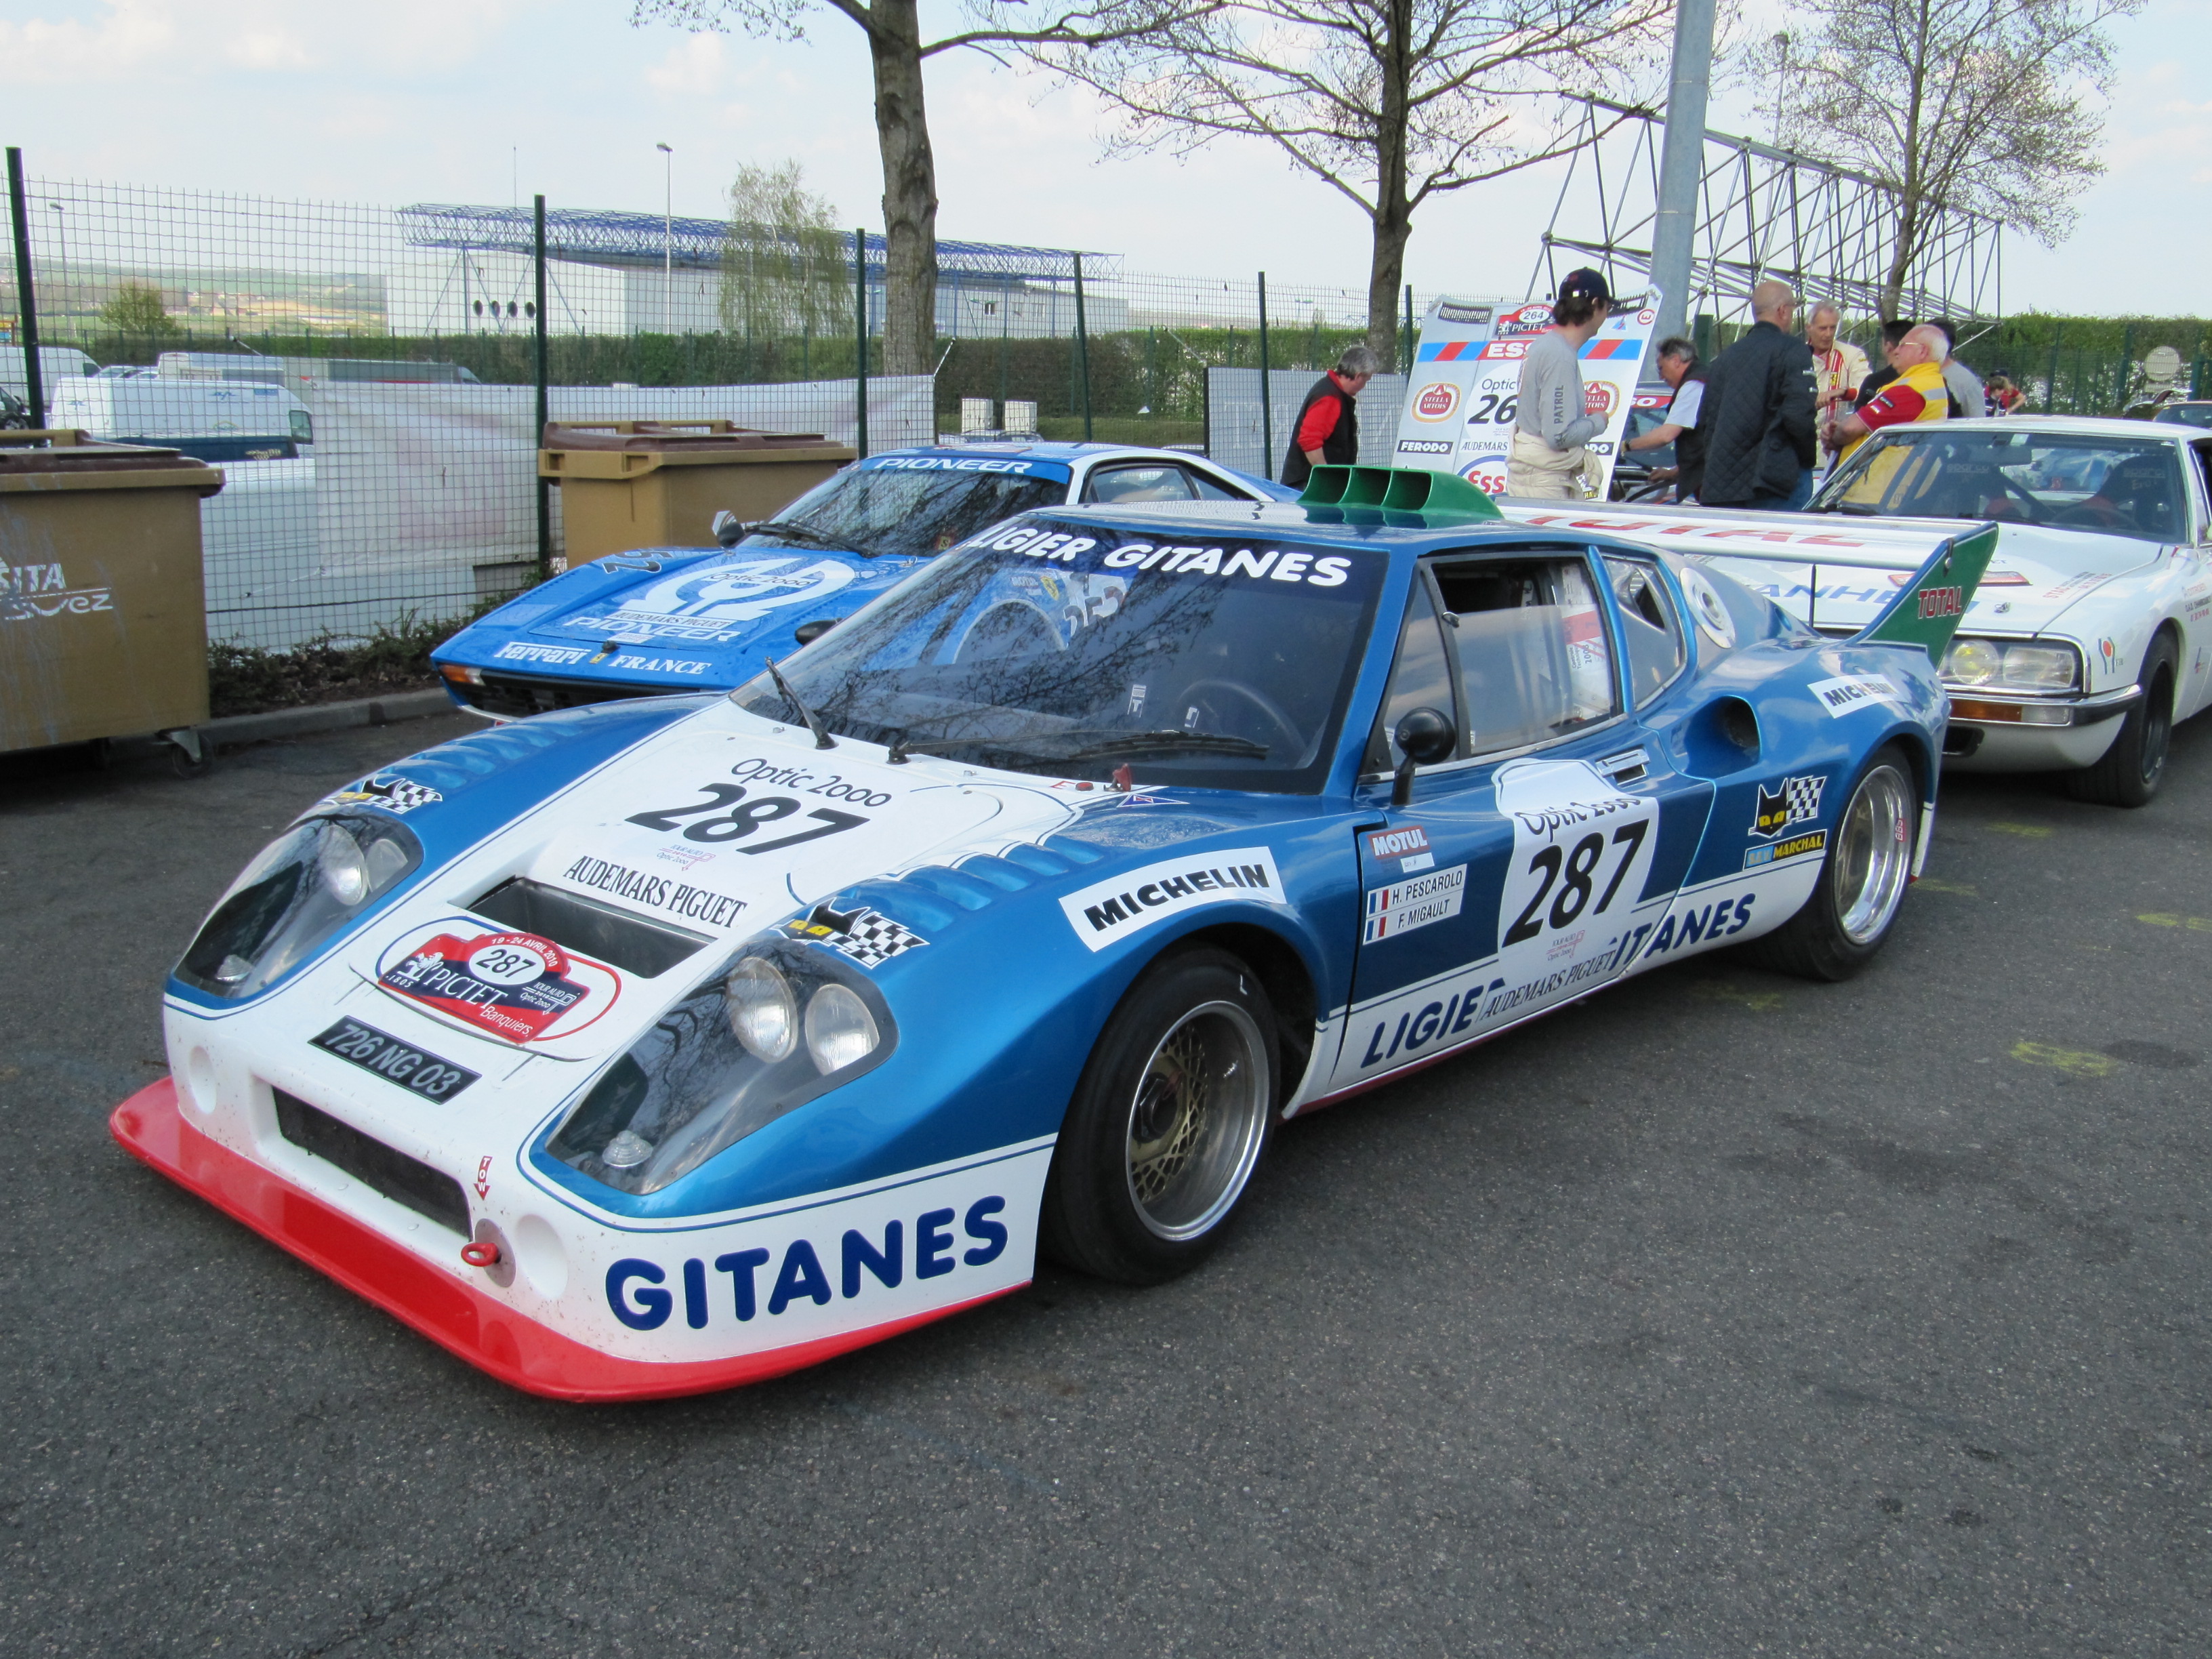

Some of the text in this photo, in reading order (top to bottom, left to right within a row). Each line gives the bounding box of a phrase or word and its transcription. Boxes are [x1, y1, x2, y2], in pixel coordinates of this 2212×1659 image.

[1509, 323, 1545, 332] PICTET
[1523, 312, 1544, 320] 264
[1487, 342, 1533, 357] ES
[1481, 378, 1516, 393] Optic
[1467, 394, 1518, 425] 26
[1553, 384, 1564, 424] PATROL
[1400, 441, 1449, 453] FERODO
[1460, 441, 1509, 451] AUDEMARS
[874, 458, 1033, 474] PIONEER
[965, 526, 1097, 562] LIGIER
[710, 573, 811, 587] Optic 2000
[1103, 544, 1352, 587] GITANES
[1918, 586, 1963, 619] TOTAL
[562, 616, 741, 642] PIONEER
[494, 641, 712, 675] Ferrari FRANCE
[731, 758, 893, 807] Optic 2000
[624, 783, 871, 855] 287
[1372, 828, 1428, 857] MOTUL
[1773, 835, 1823, 859] MARCHAL
[562, 855, 748, 928] AUDEMARS PIGUET
[1083, 863, 1271, 932] MICHELIN
[1392, 870, 1462, 905] H. PESCAROLO
[1501, 818, 1650, 948] 287
[1397, 899, 1450, 928] F. MIGAULT
[1607, 893, 1757, 971] ITANES
[475, 948, 537, 978] 287
[512, 937, 523, 945] 24
[523, 938, 547, 954] AVRIL
[545, 949, 558, 967] 2010
[388, 975, 413, 988] 1805
[430, 967, 508, 1010] PICTET
[520, 991, 537, 1002] Optic
[533, 981, 552, 992] TOUR
[1480, 949, 1618, 1021] AUDEMARS PIGUET
[480, 1006, 534, 1036] Banquiers
[325, 1023, 462, 1094] 726 NG 03
[478, 1157, 491, 1192] TOW
[605, 1195, 1008, 1331] GITANES
